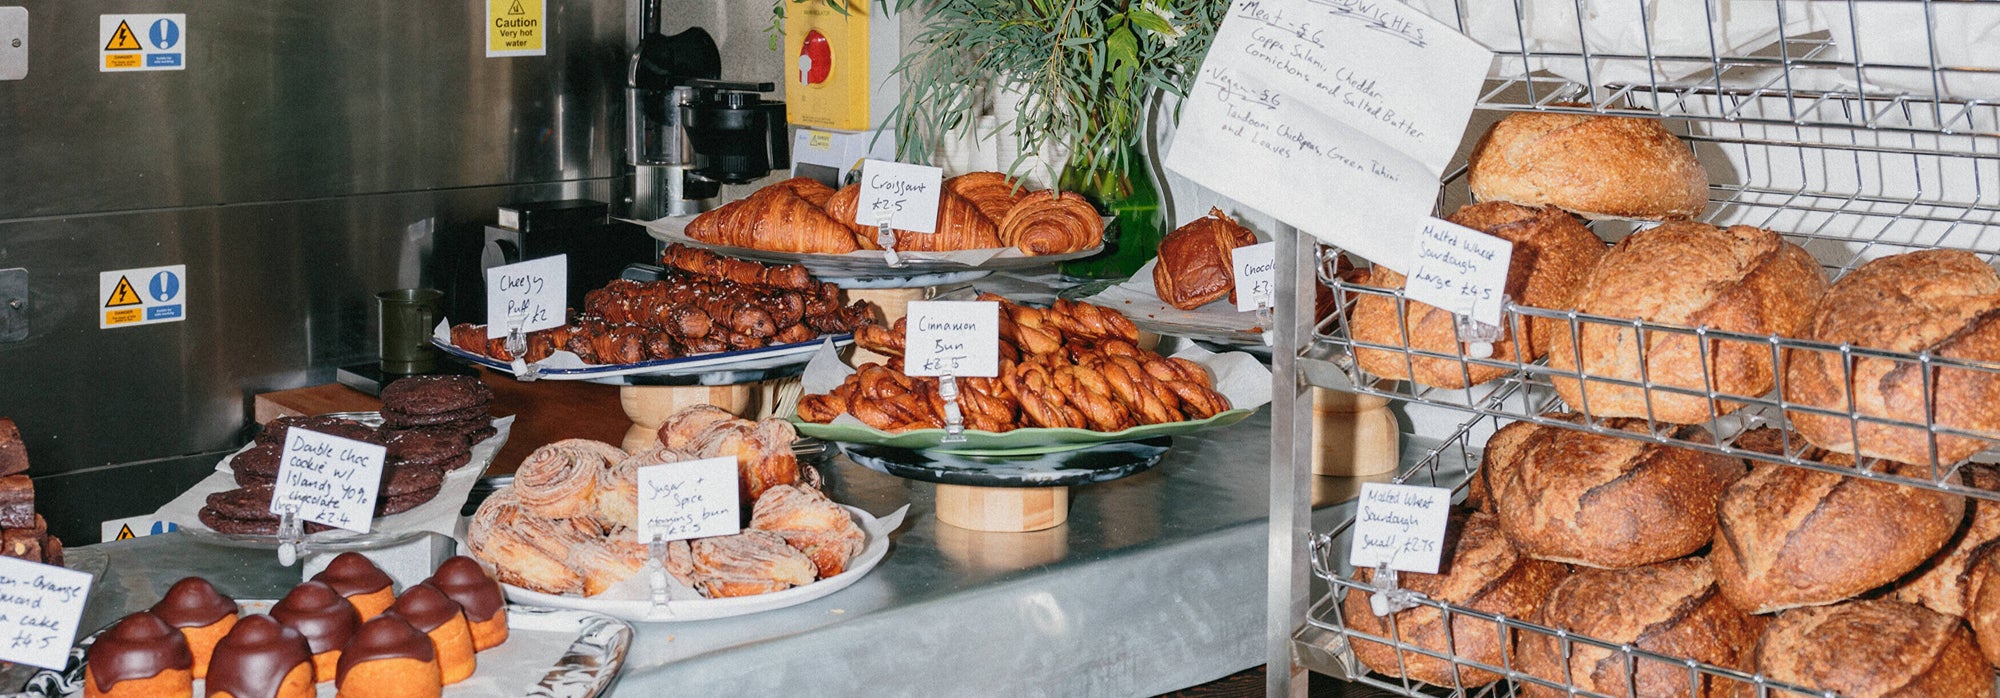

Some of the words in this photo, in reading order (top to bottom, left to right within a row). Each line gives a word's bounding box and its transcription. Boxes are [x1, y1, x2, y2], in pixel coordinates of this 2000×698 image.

[495, 17, 537, 28] Caution
[1241, 1, 1282, 25] Meat
[500, 29, 518, 38] Very
[1251, 27, 1284, 50] Coppa
[1212, 67, 1248, 101] Vegan
[1245, 44, 1309, 81] Cornichons
[1316, 82, 1341, 97] and
[1343, 92, 1382, 119] Salted
[1221, 125, 1244, 137] and
[1251, 131, 1290, 158] Leaves
[1227, 103, 1269, 130] Tandoori
[1327, 147, 1364, 171] Green
[1371, 160, 1399, 181] Tahini
[871, 174, 926, 196] Croissant
[872, 198, 907, 211] £2.5
[1422, 226, 1457, 246] Malted
[1463, 240, 1494, 260] Wheat
[1419, 241, 1476, 274] Sourdough
[500, 275, 544, 295] Cheesy
[1415, 265, 1451, 289] Large
[1461, 282, 1492, 299] £4.5
[508, 299, 530, 316] Puff
[532, 304, 547, 324] £2
[919, 315, 976, 331] Cinnamon
[935, 339, 963, 353] Bun
[923, 356, 967, 370] £25
[292, 436, 333, 458] Double
[333, 469, 355, 480] w/
[341, 484, 368, 504] 40%
[648, 480, 685, 500] Sugar
[674, 488, 703, 510] Spice
[1368, 490, 1400, 504] Malted
[1404, 493, 1434, 509] Wheat
[702, 507, 729, 520] bun
[1363, 506, 1418, 532] Sourdough
[0, 593, 42, 608] mond
[19, 615, 59, 631] cake
[11, 630, 58, 649] £4.5
